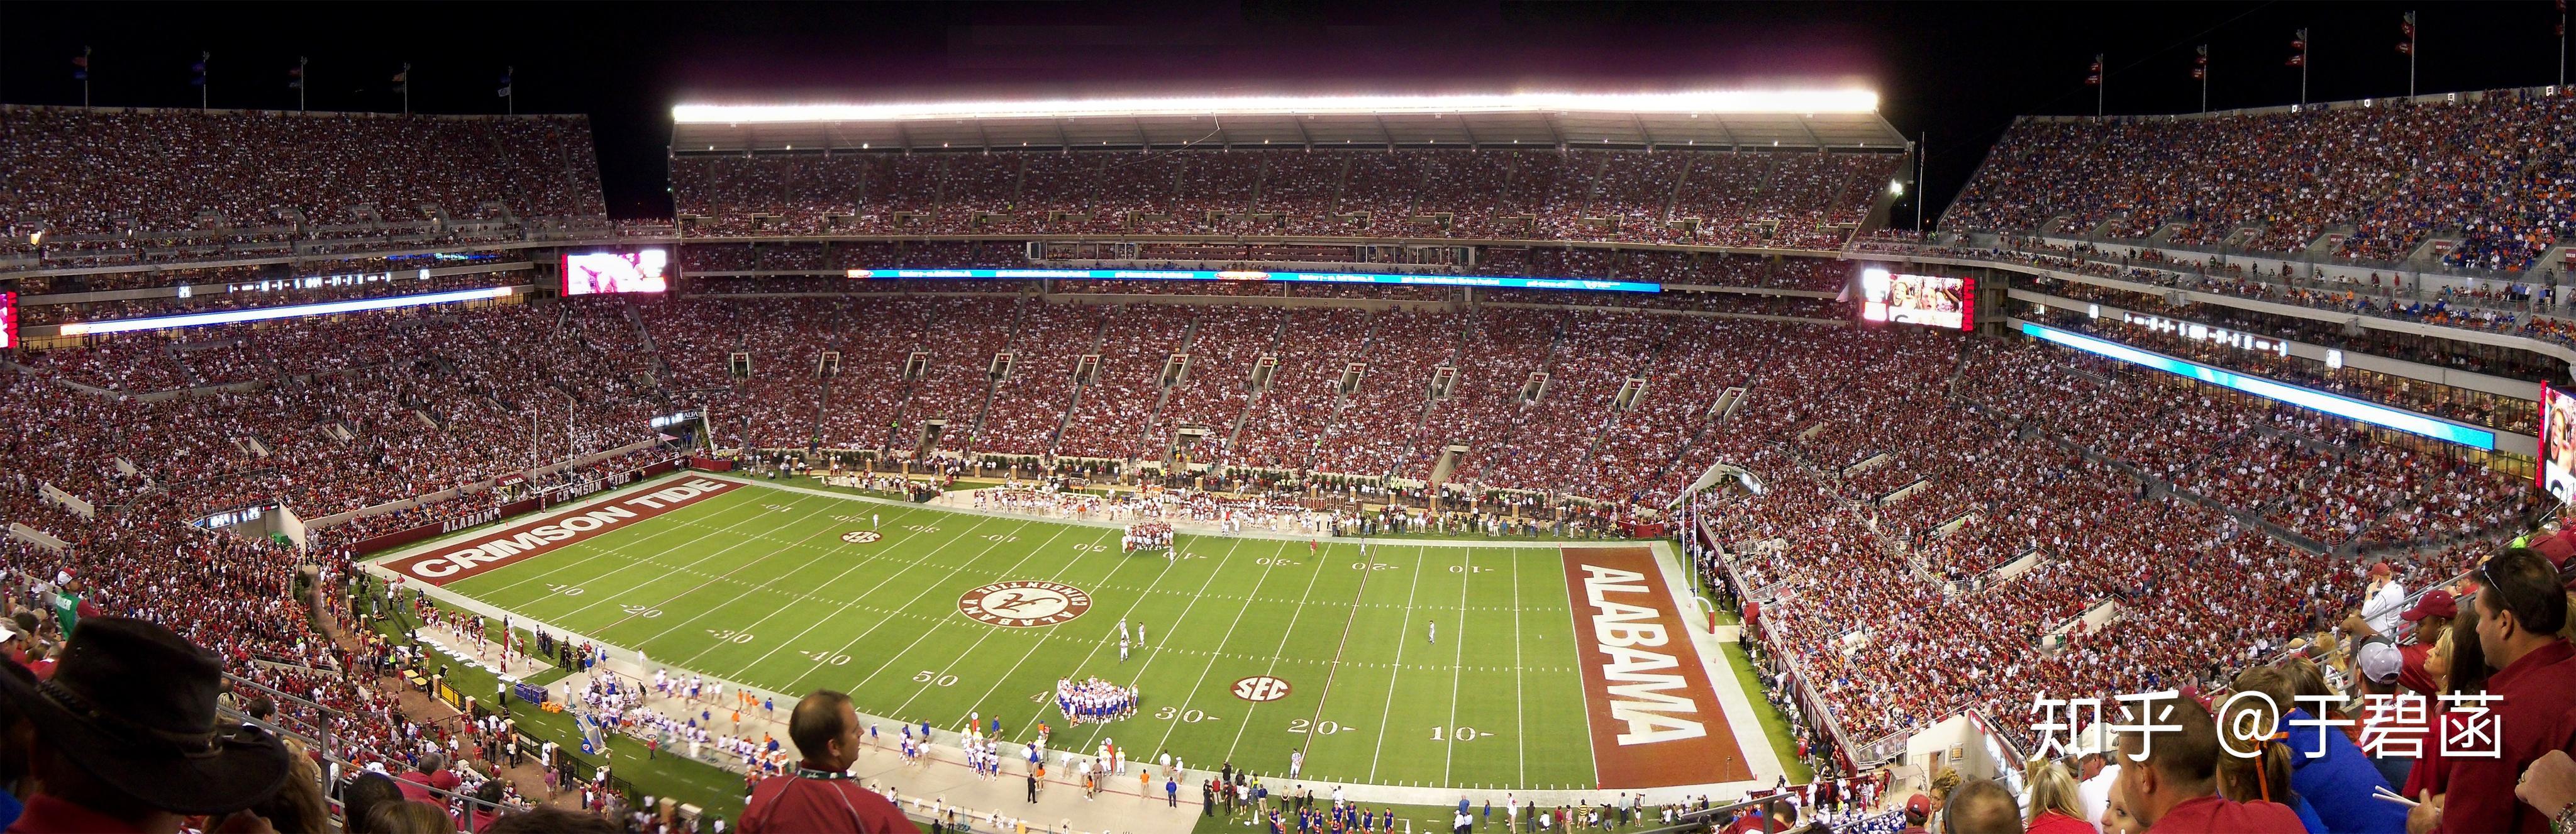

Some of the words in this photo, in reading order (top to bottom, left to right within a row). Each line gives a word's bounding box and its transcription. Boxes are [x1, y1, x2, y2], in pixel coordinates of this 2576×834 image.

[503, 477, 524, 487] BAMA
[556, 481, 602, 503] CRMSON
[412, 505, 636, 577] CRIMSON
[624, 478, 728, 509] TIDE
[443, 510, 496, 533] ALABAM
[554, 584, 584, 596] 10
[624, 605, 662, 618] 20
[711, 630, 754, 643] 30
[809, 651, 851, 665] 40
[1581, 564, 1707, 746] ALABAMA
[913, 670, 959, 687] 50
[1234, 677, 1288, 701] SEC
[1155, 706, 1204, 723] 30
[1287, 718, 1339, 735] 20
[1430, 725, 1476, 741] 10
